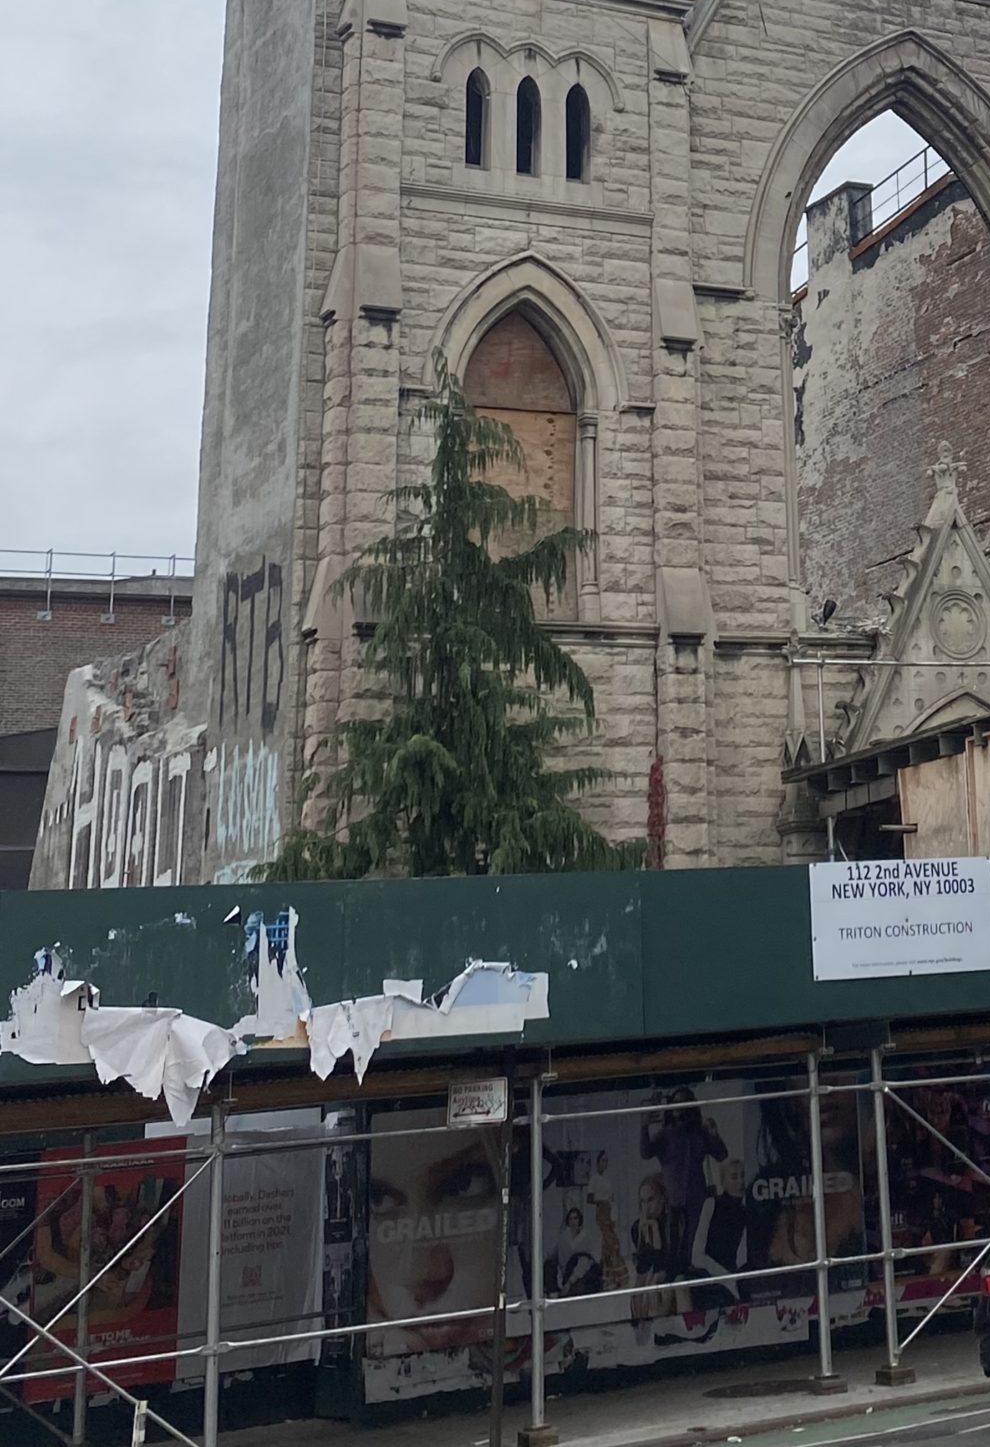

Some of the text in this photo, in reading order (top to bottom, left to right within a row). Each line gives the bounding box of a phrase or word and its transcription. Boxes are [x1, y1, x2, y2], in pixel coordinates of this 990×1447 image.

[847, 861, 959, 881] 112 2nd AVENUE
[831, 878, 975, 900] NEW YORK, NY 10003
[838, 921, 974, 941] TRITON CONSTRUCTION
[220, 1229, 256, 1242] latform
[375, 1207, 498, 1244] GRAILED
